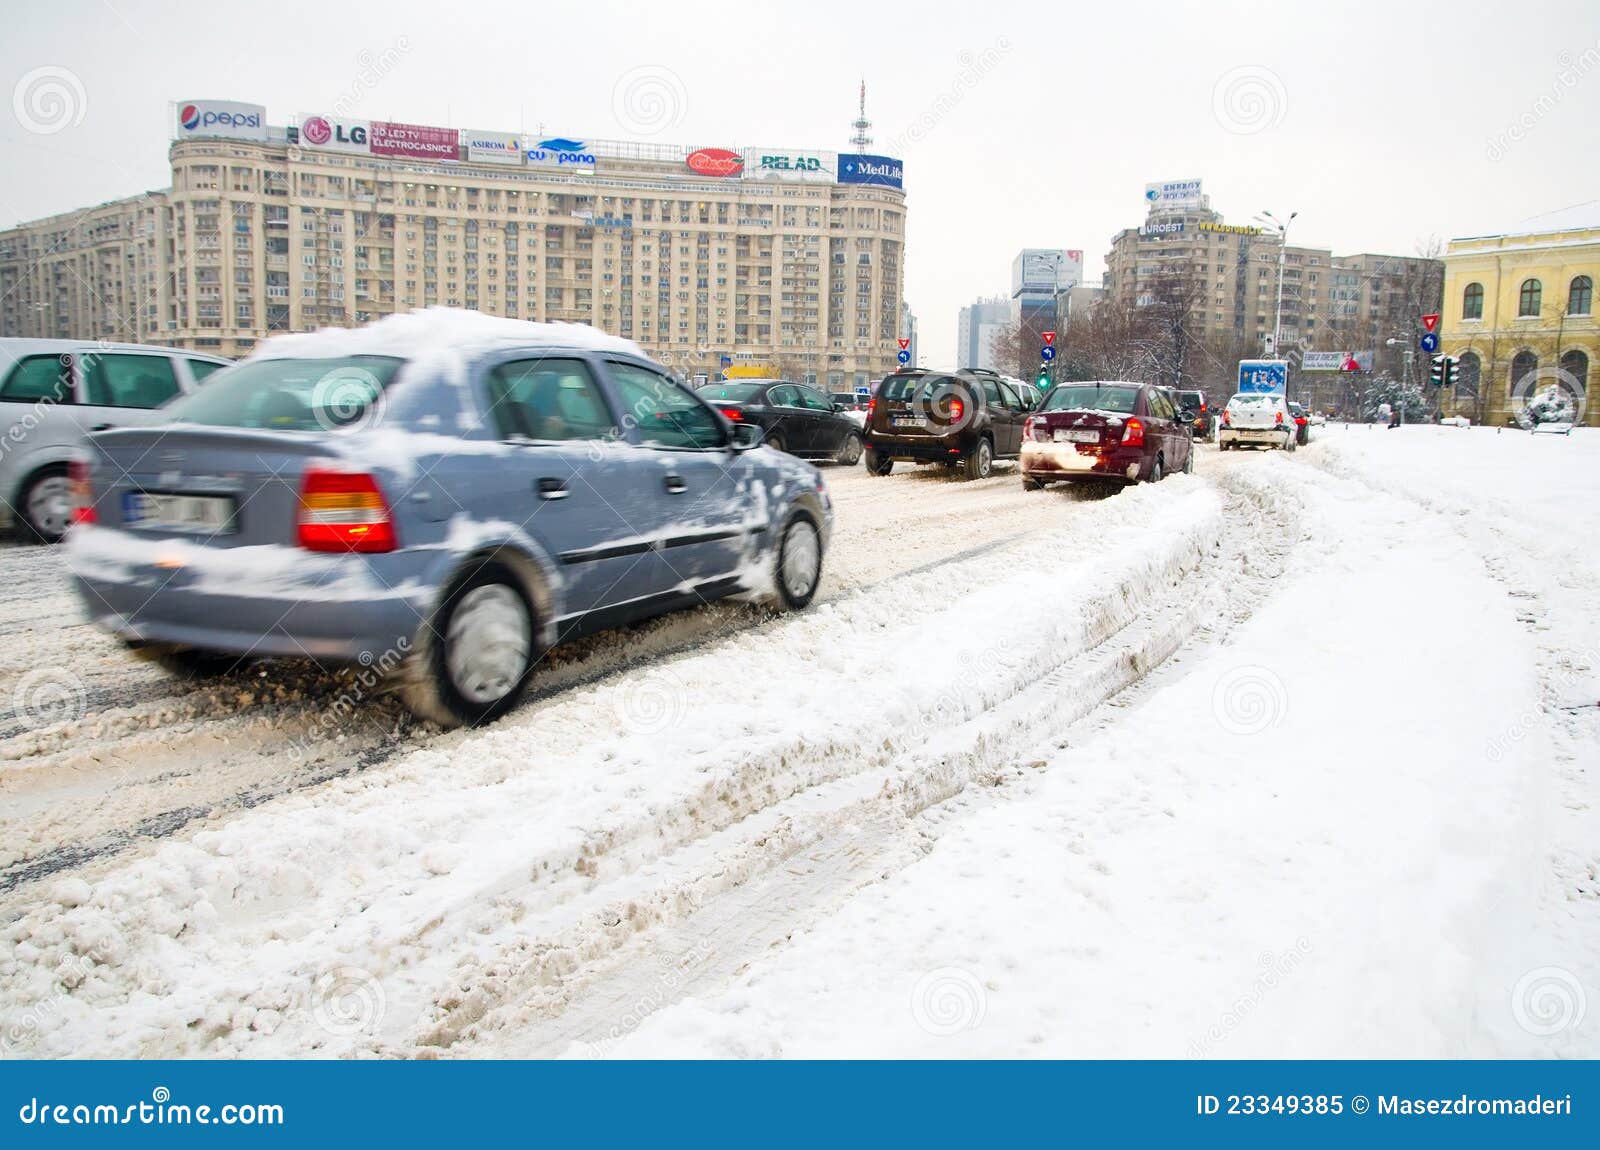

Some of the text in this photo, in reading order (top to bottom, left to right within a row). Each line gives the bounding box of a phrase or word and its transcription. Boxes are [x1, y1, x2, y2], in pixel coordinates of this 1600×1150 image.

[203, 111, 260, 128] pepsi
[335, 124, 367, 144] LG
[387, 129, 406, 139] LED
[406, 130, 418, 139] TV
[373, 138, 453, 153] ELECTROCASNICE
[471, 140, 505, 149] ASIROM
[761, 155, 821, 171] RELAD
